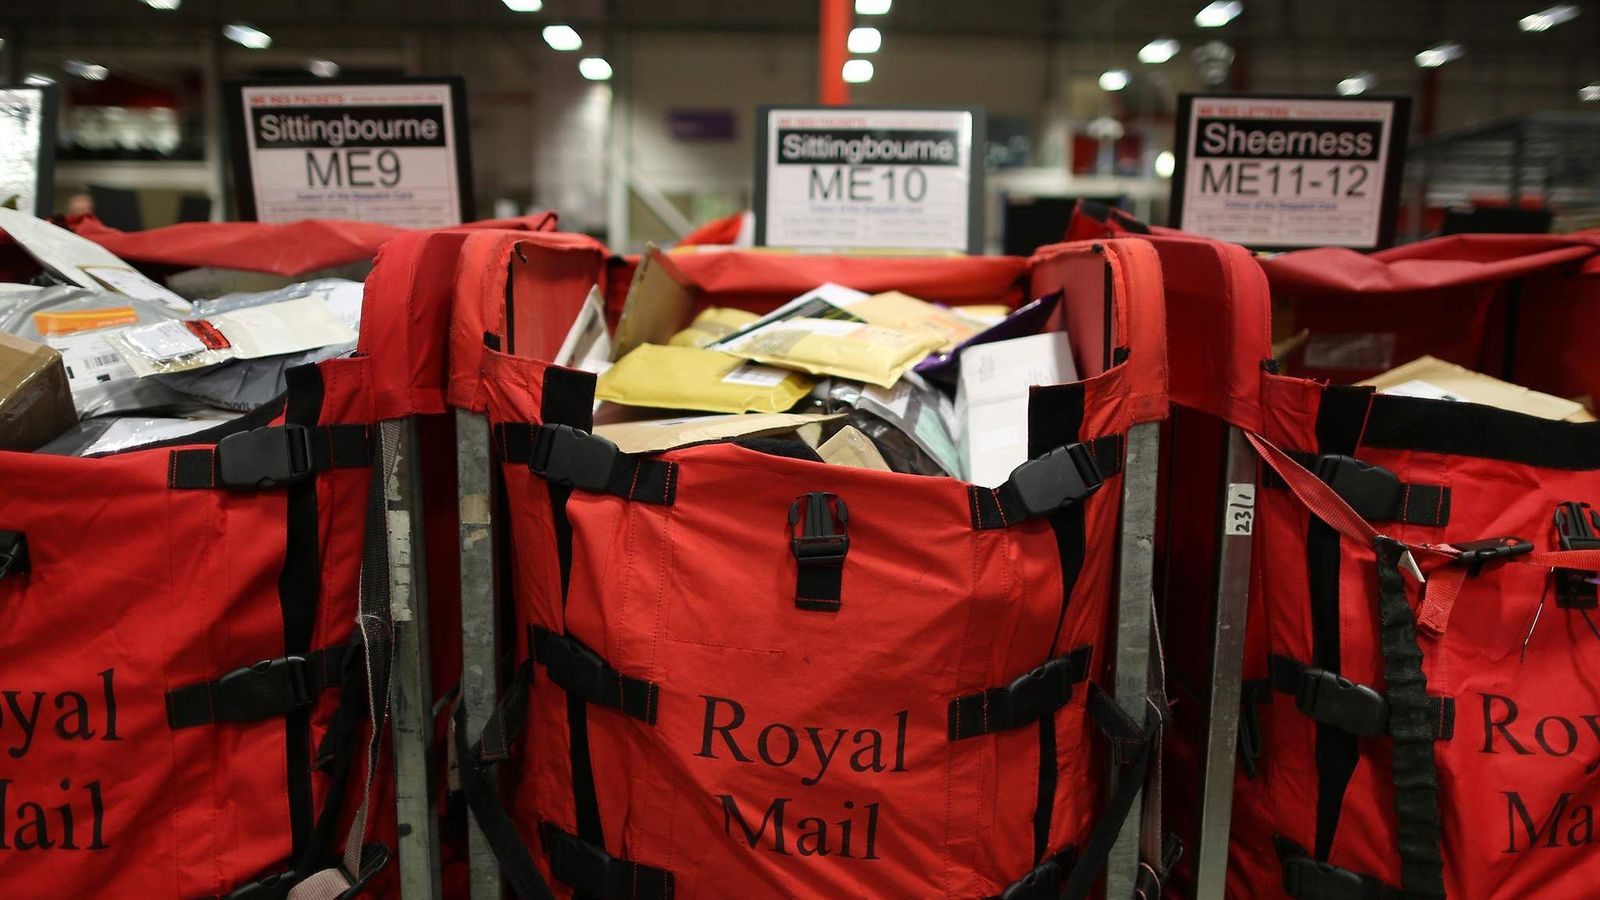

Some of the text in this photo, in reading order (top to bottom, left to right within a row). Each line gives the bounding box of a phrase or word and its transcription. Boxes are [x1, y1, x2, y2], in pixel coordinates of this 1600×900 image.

[260, 114, 439, 146] Sittingbourne
[782, 132, 954, 163] Sittingbourne
[1202, 121, 1373, 156] Sheerness
[306, 150, 402, 189] ME9
[808, 166, 927, 202] ME10
[1200, 162, 1369, 198] ME11-12
[0, 667, 124, 759] yal
[692, 694, 910, 786] Royal
[0, 777, 111, 851] ail
[714, 794, 881, 860] Mail
